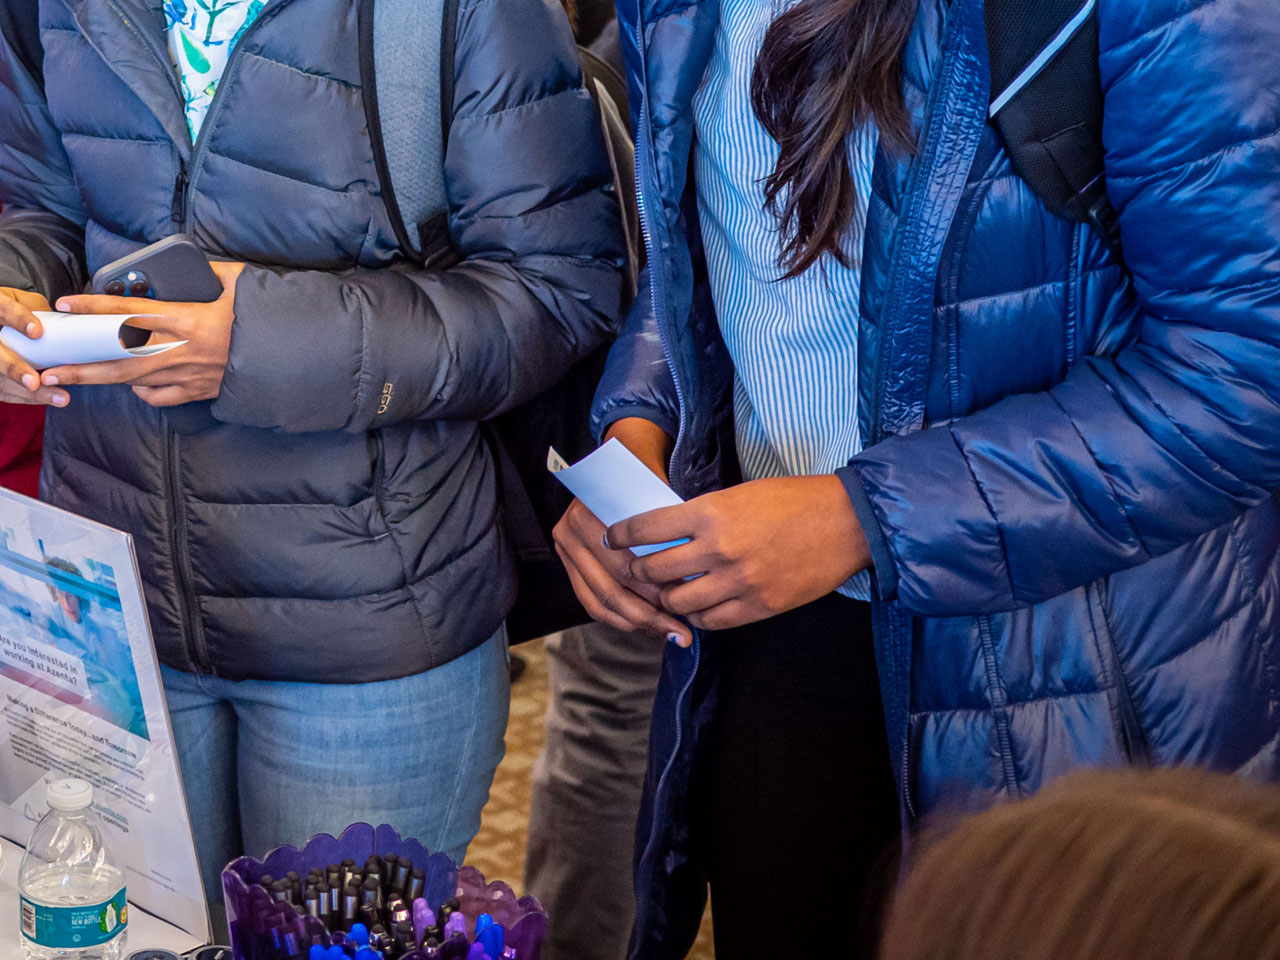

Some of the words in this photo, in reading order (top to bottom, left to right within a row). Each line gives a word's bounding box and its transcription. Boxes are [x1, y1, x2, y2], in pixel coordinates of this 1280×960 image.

[3, 648, 35, 669] working
[36, 660, 45, 671] at
[46, 665, 78, 686] Azenta?
[12, 641, 27, 653] you
[28, 645, 68, 671] interested
[70, 664, 78, 675] in
